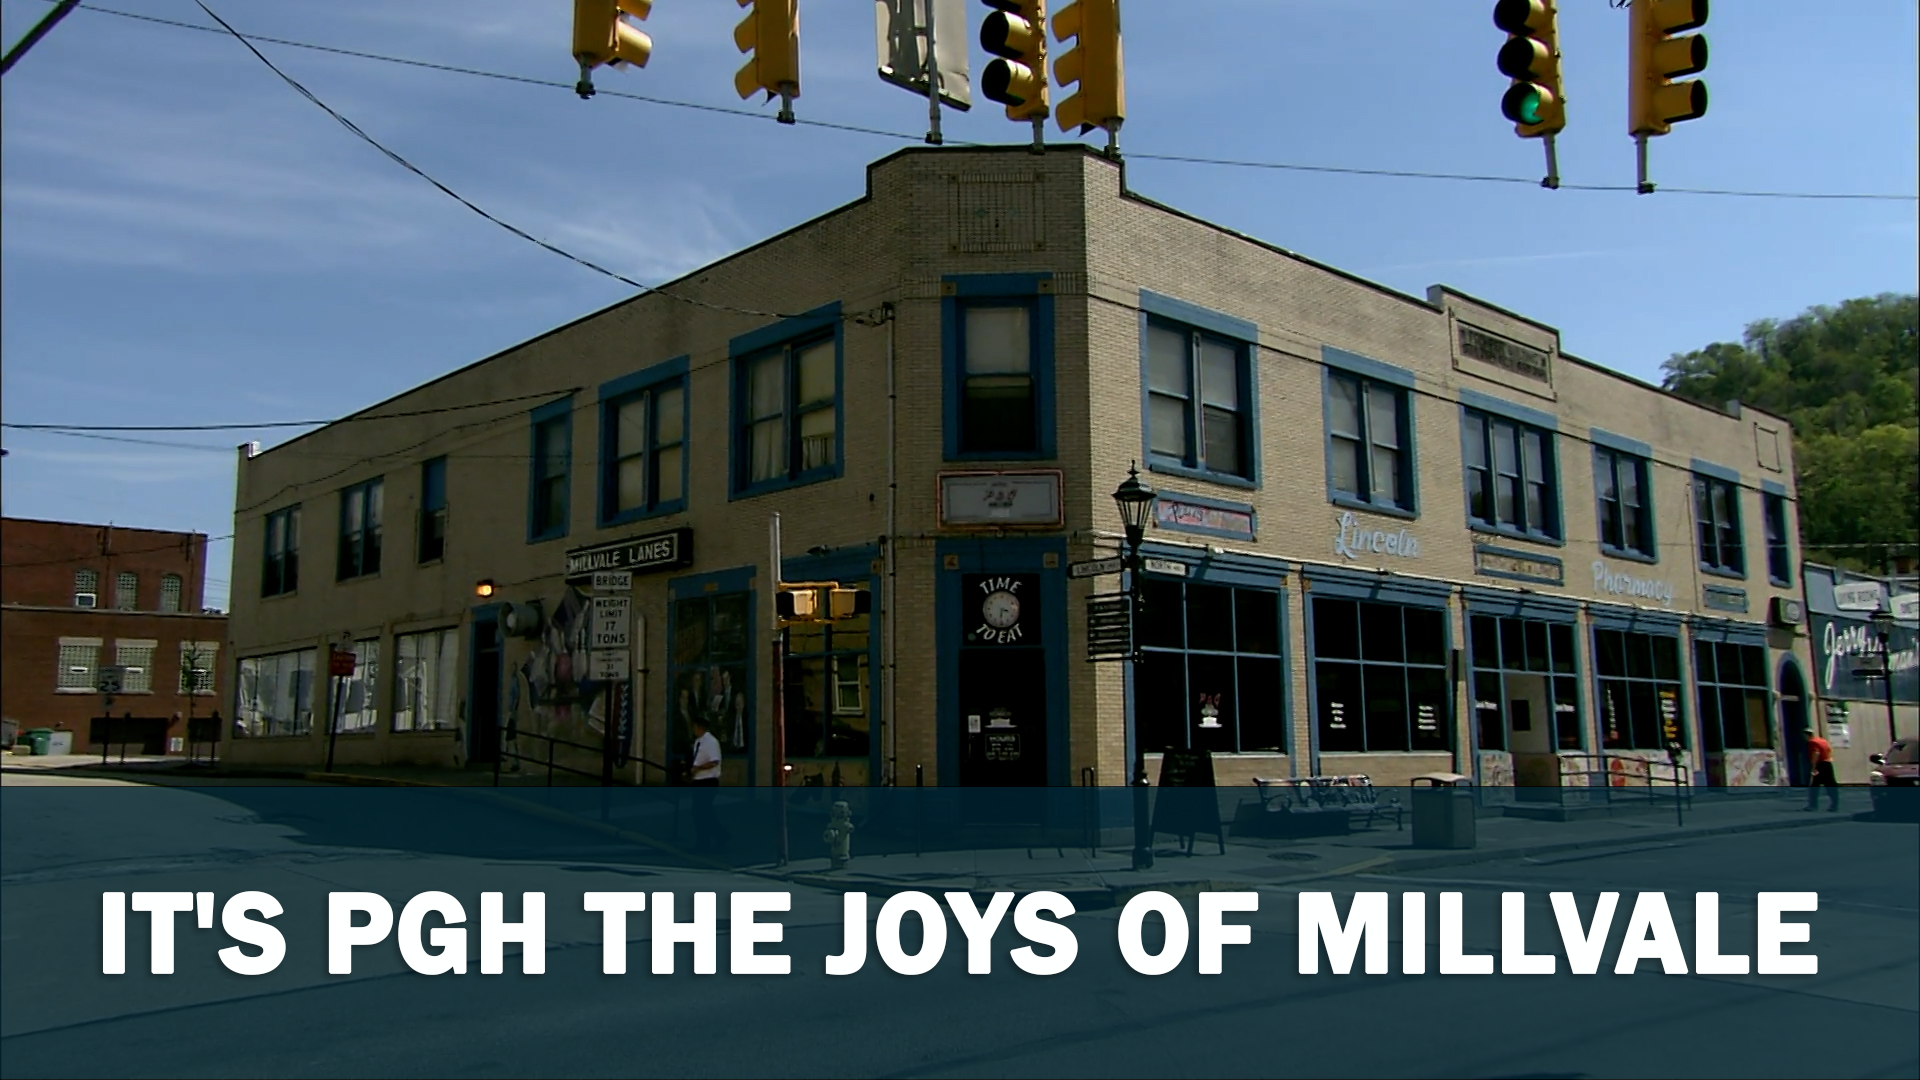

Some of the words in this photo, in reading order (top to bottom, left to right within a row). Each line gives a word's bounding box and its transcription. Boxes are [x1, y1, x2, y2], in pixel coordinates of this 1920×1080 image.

[1333, 511, 1419, 559] Lincoln
[569, 550, 621, 574] MILLVALE
[629, 540, 672, 564] LANES
[596, 575, 629, 586] BRIDGE
[979, 576, 1024, 595] TIME
[1592, 560, 1674, 606] Pharmacy
[595, 599, 628, 607] WEIGHT
[600, 610, 622, 618] LIMIT
[605, 621, 616, 631] 17
[597, 633, 626, 644] TONS
[975, 623, 997, 641] TO
[997, 623, 1023, 644] EAT
[99, 680, 121, 692] 25
